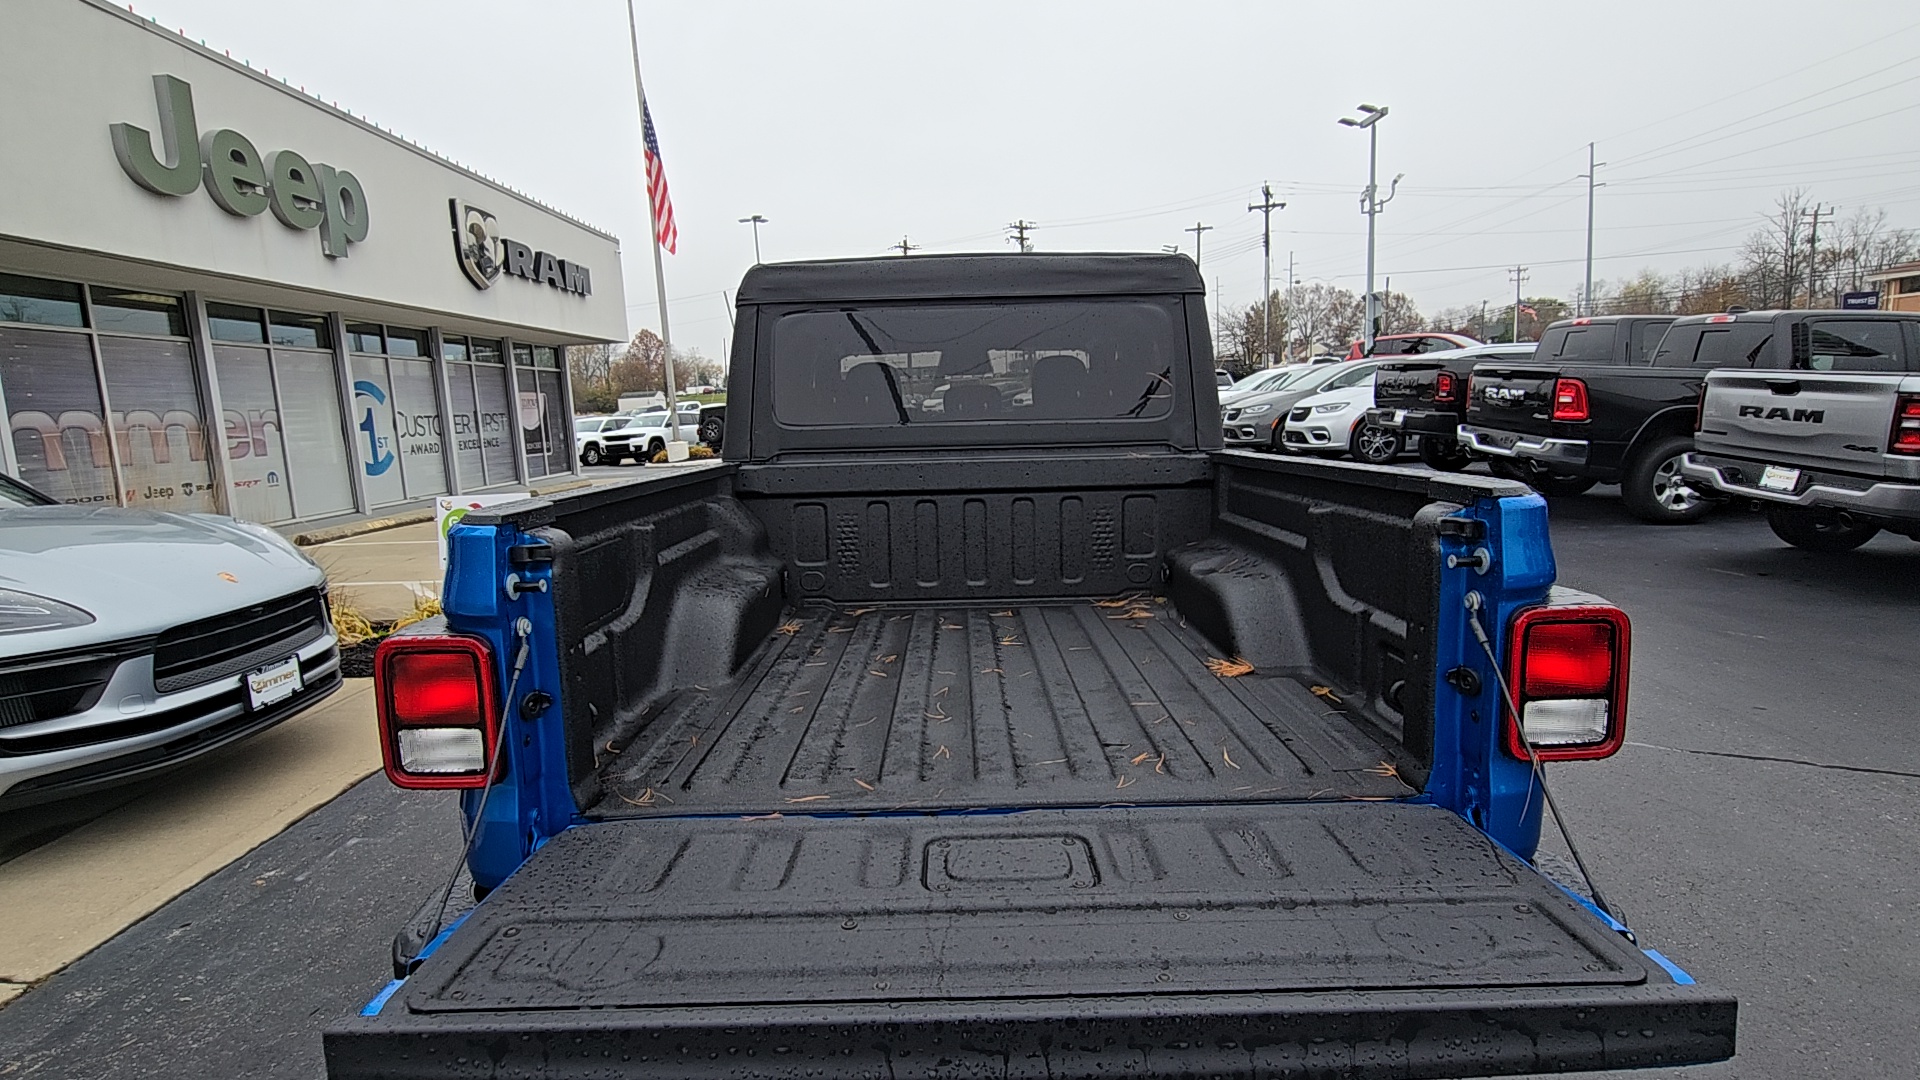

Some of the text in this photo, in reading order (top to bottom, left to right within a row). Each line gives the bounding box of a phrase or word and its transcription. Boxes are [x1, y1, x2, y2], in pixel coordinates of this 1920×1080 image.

[109, 74, 370, 258] Jeep
[502, 238, 592, 297] RAM
[1384, 376, 1420, 387] RAM
[1484, 386, 1525, 401] RAM
[1739, 405, 1825, 424] RAM
[394, 411, 472, 439] CUSTOER
[410, 438, 500, 456] AWARD EXCELENCE
[196, 483, 215, 492] RA
[233, 479, 262, 488] SRT
[65, 494, 117, 505] DODG
[143, 485, 174, 500] Jeep
